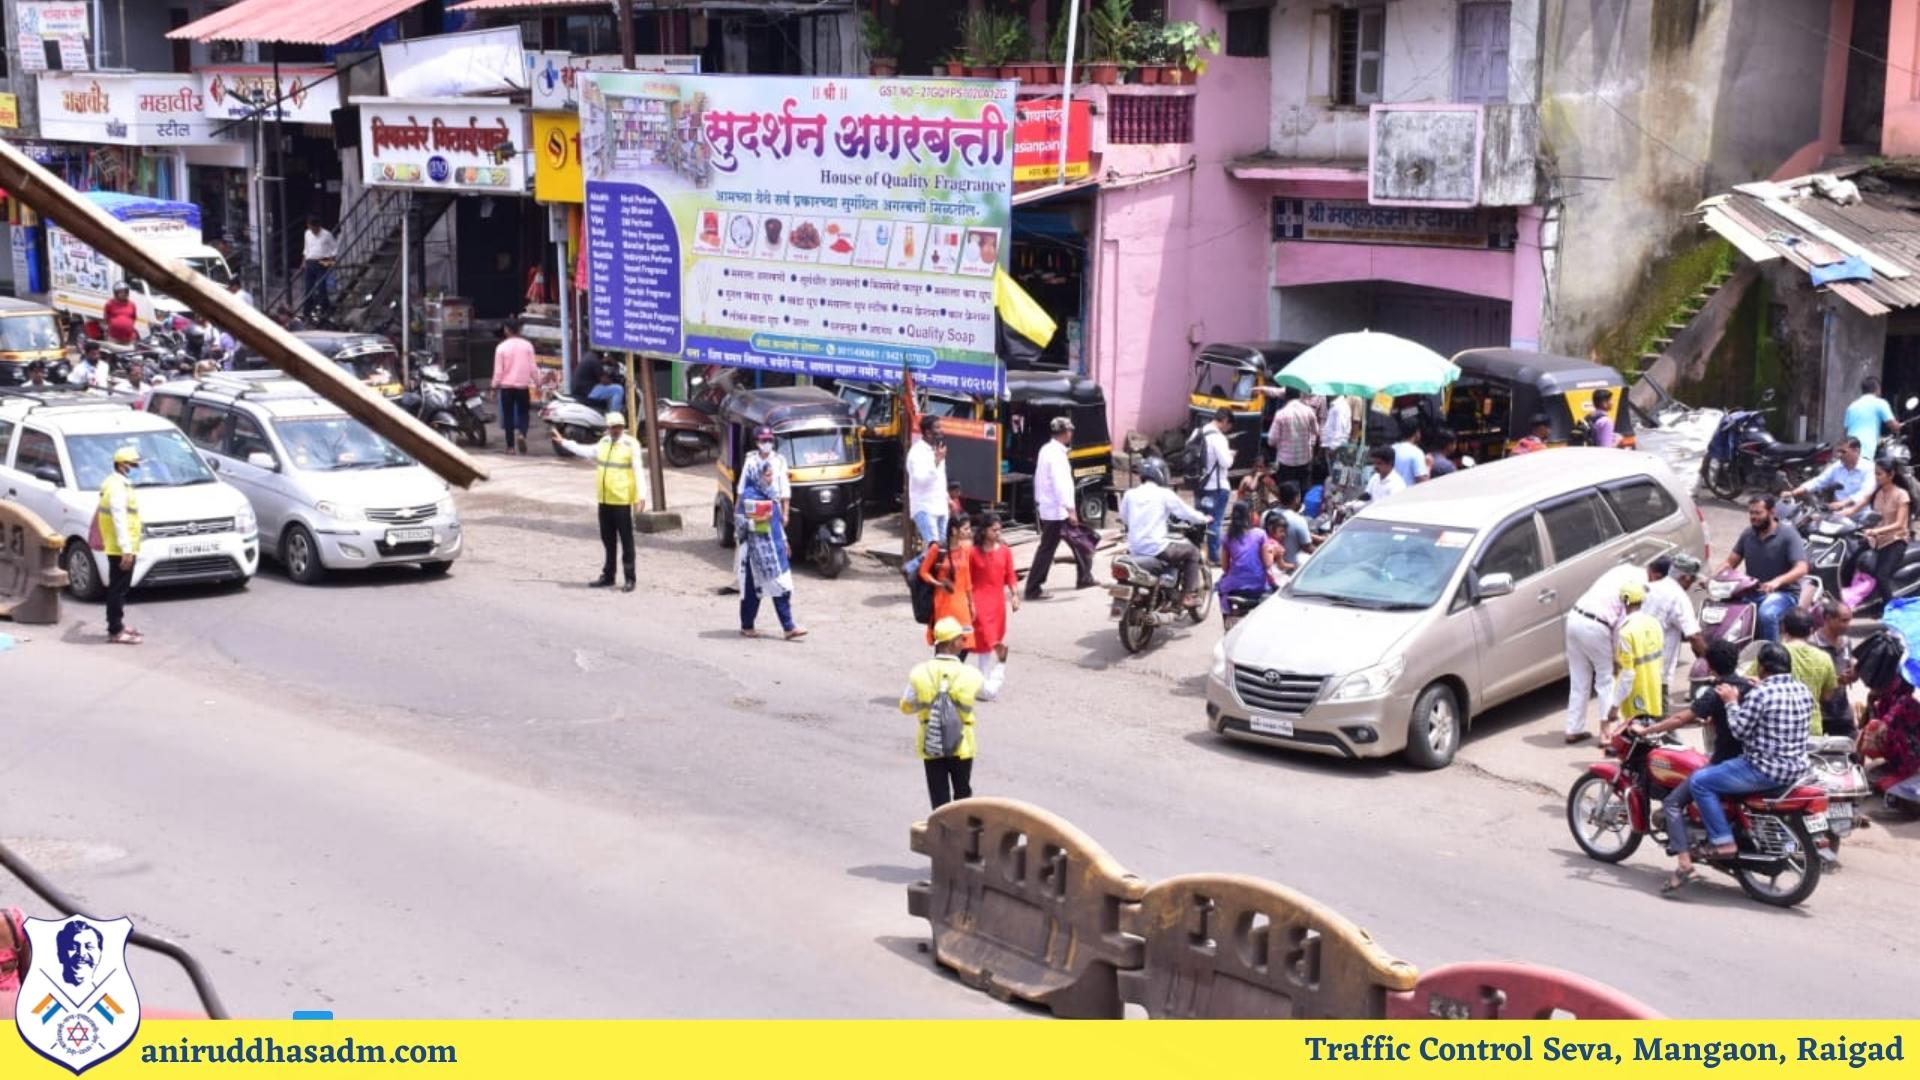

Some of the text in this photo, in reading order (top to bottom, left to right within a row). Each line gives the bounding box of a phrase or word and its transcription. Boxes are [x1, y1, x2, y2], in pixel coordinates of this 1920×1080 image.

[140, 88, 204, 114] महावीर
[157, 120, 191, 137] स्टील
[704, 97, 1008, 172] सुदर्शन अगरबत्ती
[821, 170, 1006, 194] House of Quality Fragrance
[907, 324, 975, 346] Quality Soap
